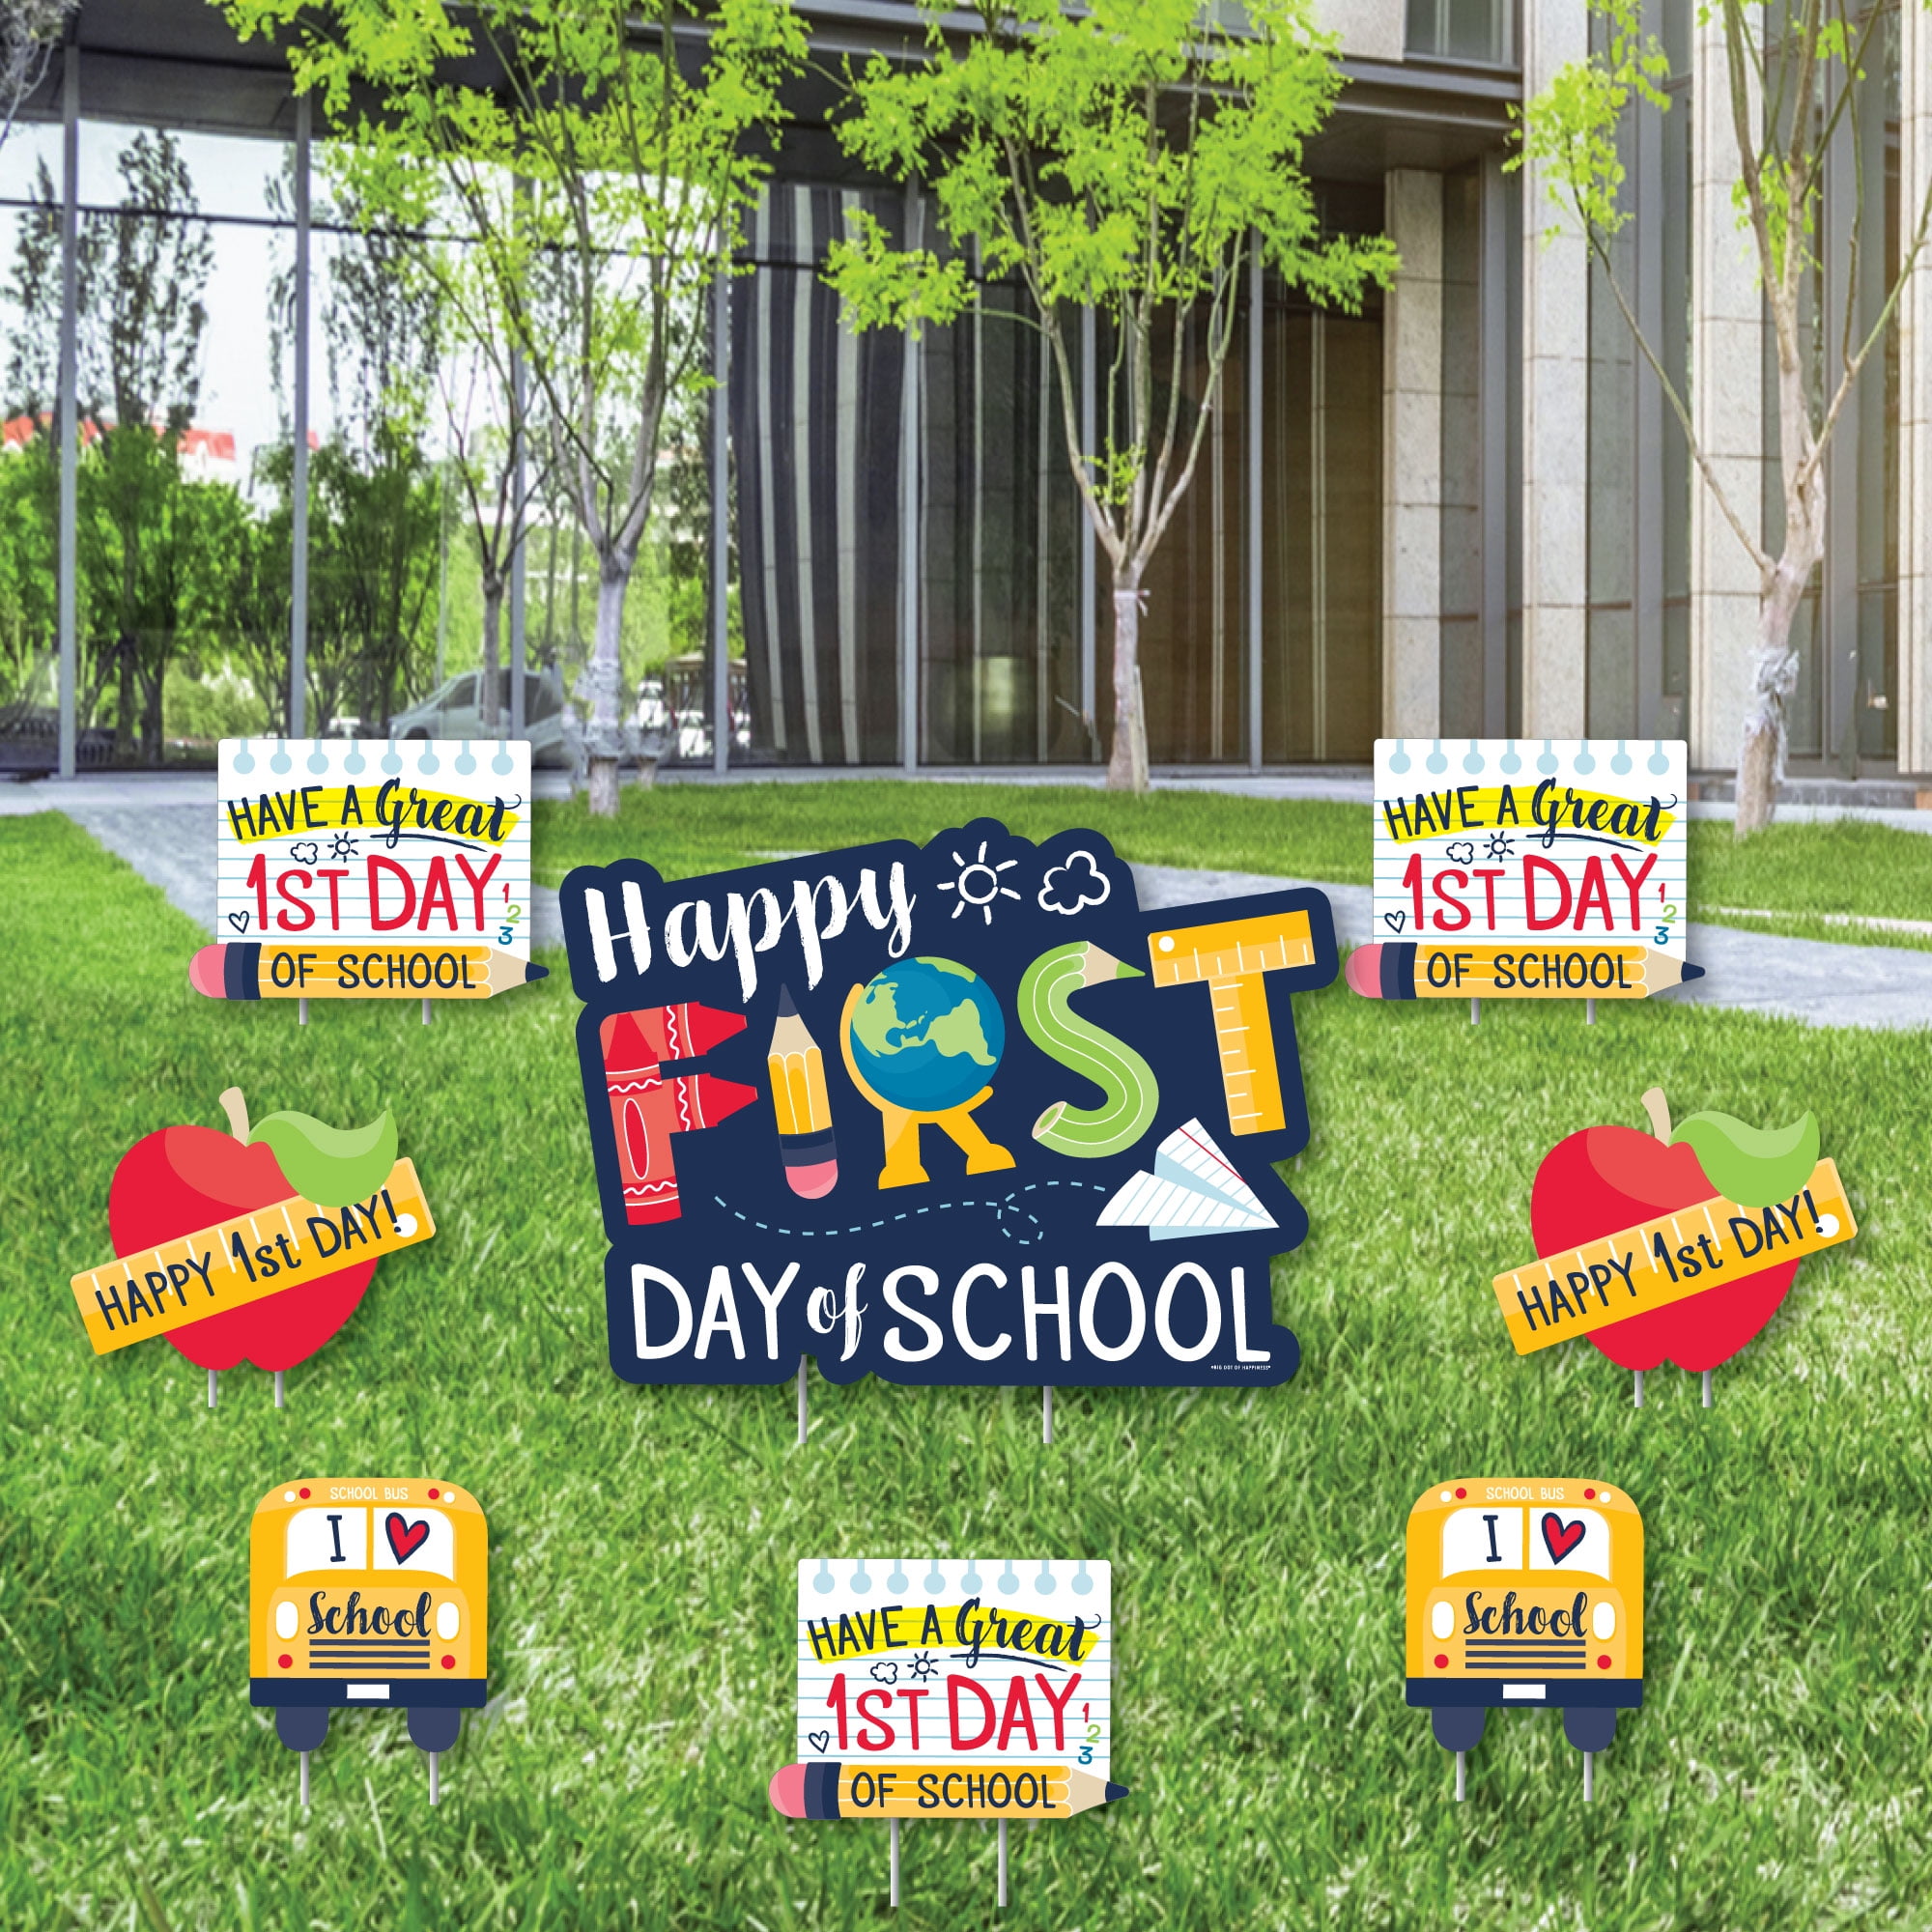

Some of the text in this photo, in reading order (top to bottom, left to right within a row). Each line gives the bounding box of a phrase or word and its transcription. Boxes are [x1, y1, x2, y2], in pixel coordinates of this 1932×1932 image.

[227, 777, 523, 849] HAVE A Great
[1383, 777, 1679, 849] HAVE A Great
[246, 853, 502, 931] 1ST DAY
[501, 883, 510, 903] 1
[505, 904, 523, 923] 2
[1403, 853, 1659, 931] 1ST DAY
[1658, 883, 1666, 903] 1
[1662, 904, 1679, 923] 2
[497, 926, 513, 946] 3
[584, 861, 917, 1004] Happy
[1654, 926, 1669, 946] 3
[270, 952, 476, 989] OF SCHOOL
[1427, 952, 1633, 989] OF SCHOOL
[599, 909, 1317, 1226] FIRST
[95, 1189, 402, 1331] HAPPY 1st DAY!
[1517, 1189, 1824, 1331] HAPPY 1st DAY!
[631, 1262, 1270, 1363] DAY of SCHOOL
[329, 1487, 409, 1500] SCHOOL BUS
[1486, 1487, 1565, 1500] SCHOOL BUS
[327, 1515, 346, 1562] I
[1483, 1515, 1502, 1562] I
[306, 1590, 432, 1638] School
[807, 1597, 1102, 1669] HAVE A Great
[1463, 1590, 1588, 1638] School
[826, 1673, 1082, 1751] 1ST DAY
[1081, 1703, 1090, 1723] 1
[1085, 1724, 1102, 1744] 2
[1077, 1747, 1093, 1766] 3
[850, 1772, 1056, 1809] OF SCHOOL
